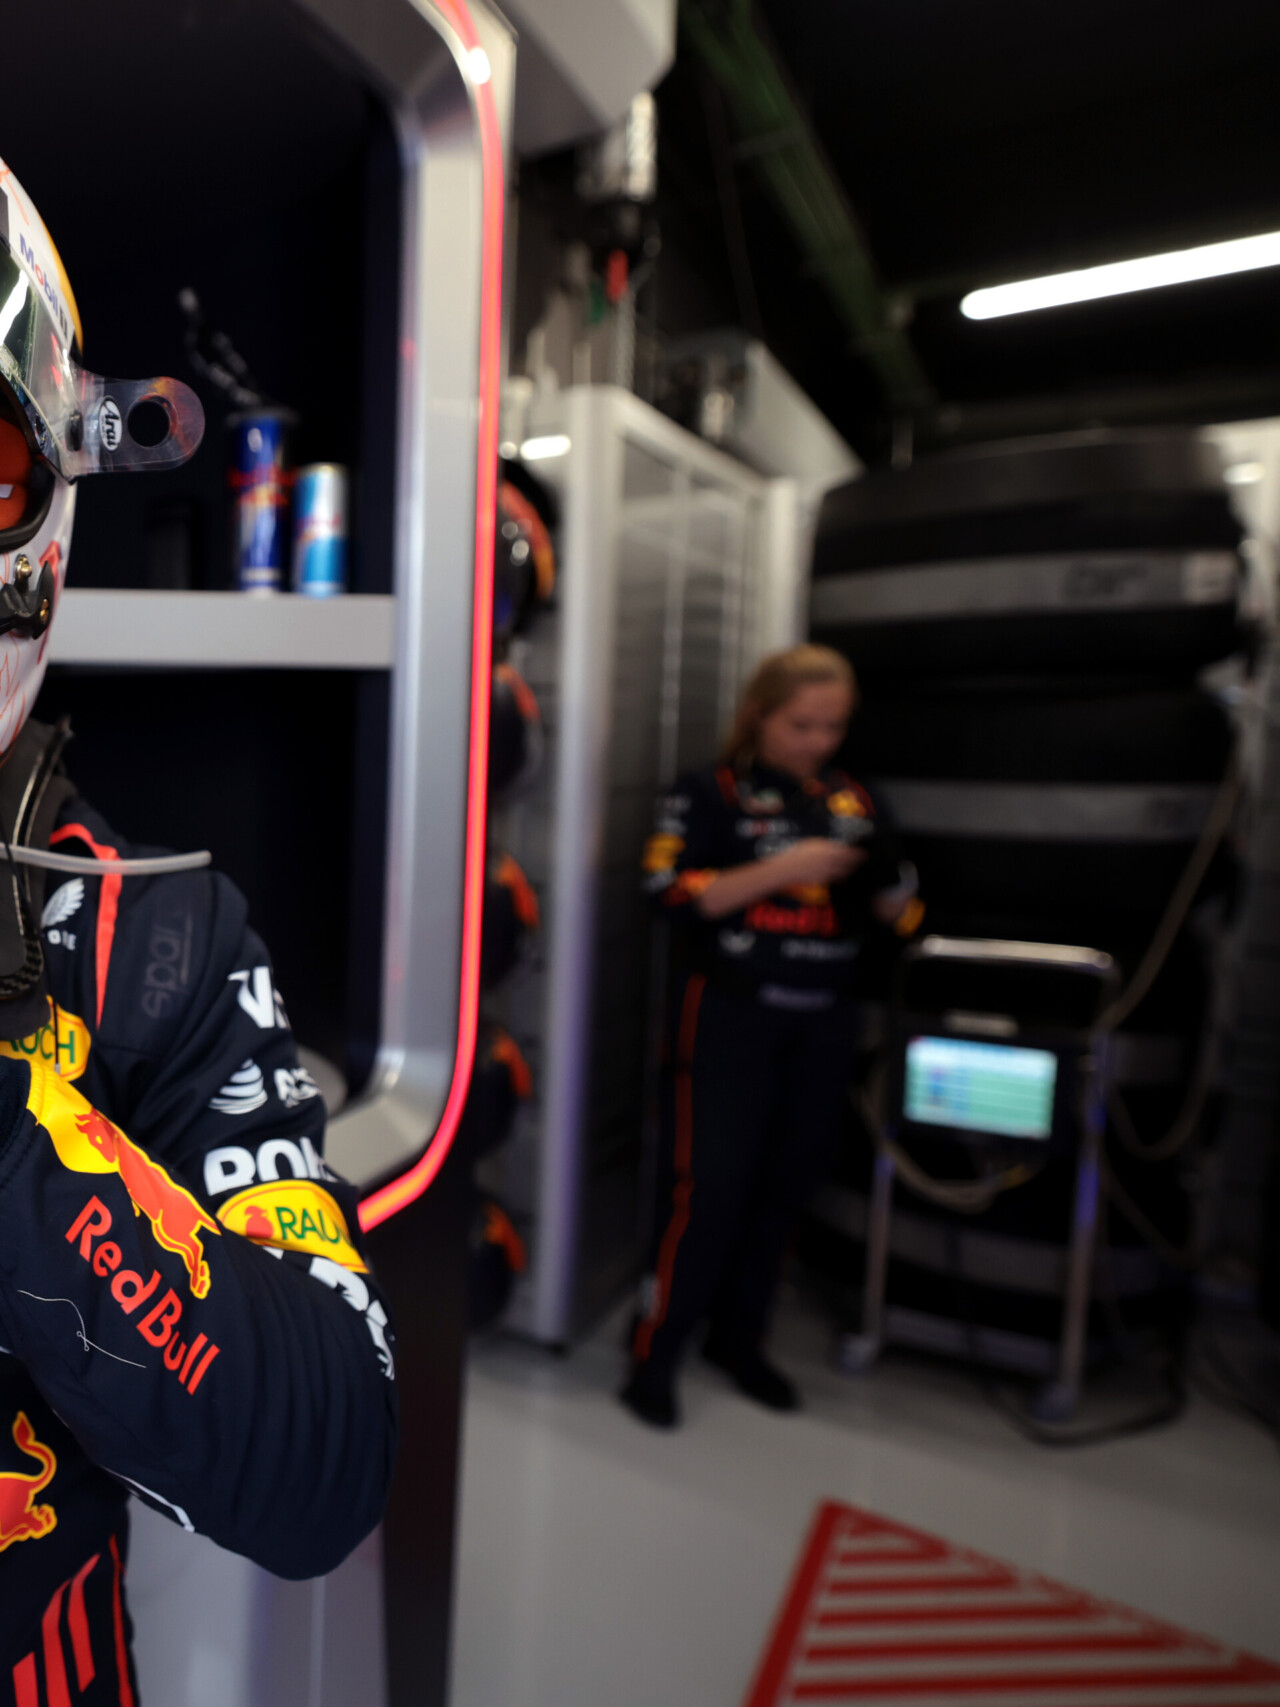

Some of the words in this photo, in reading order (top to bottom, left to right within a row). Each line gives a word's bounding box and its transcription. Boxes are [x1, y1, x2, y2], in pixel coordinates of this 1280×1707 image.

[19, 231, 59, 316] Mobil
[102, 401, 120, 447] Arai
[8, 1023, 76, 1065] UCH
[275, 1205, 357, 1249] RAU
